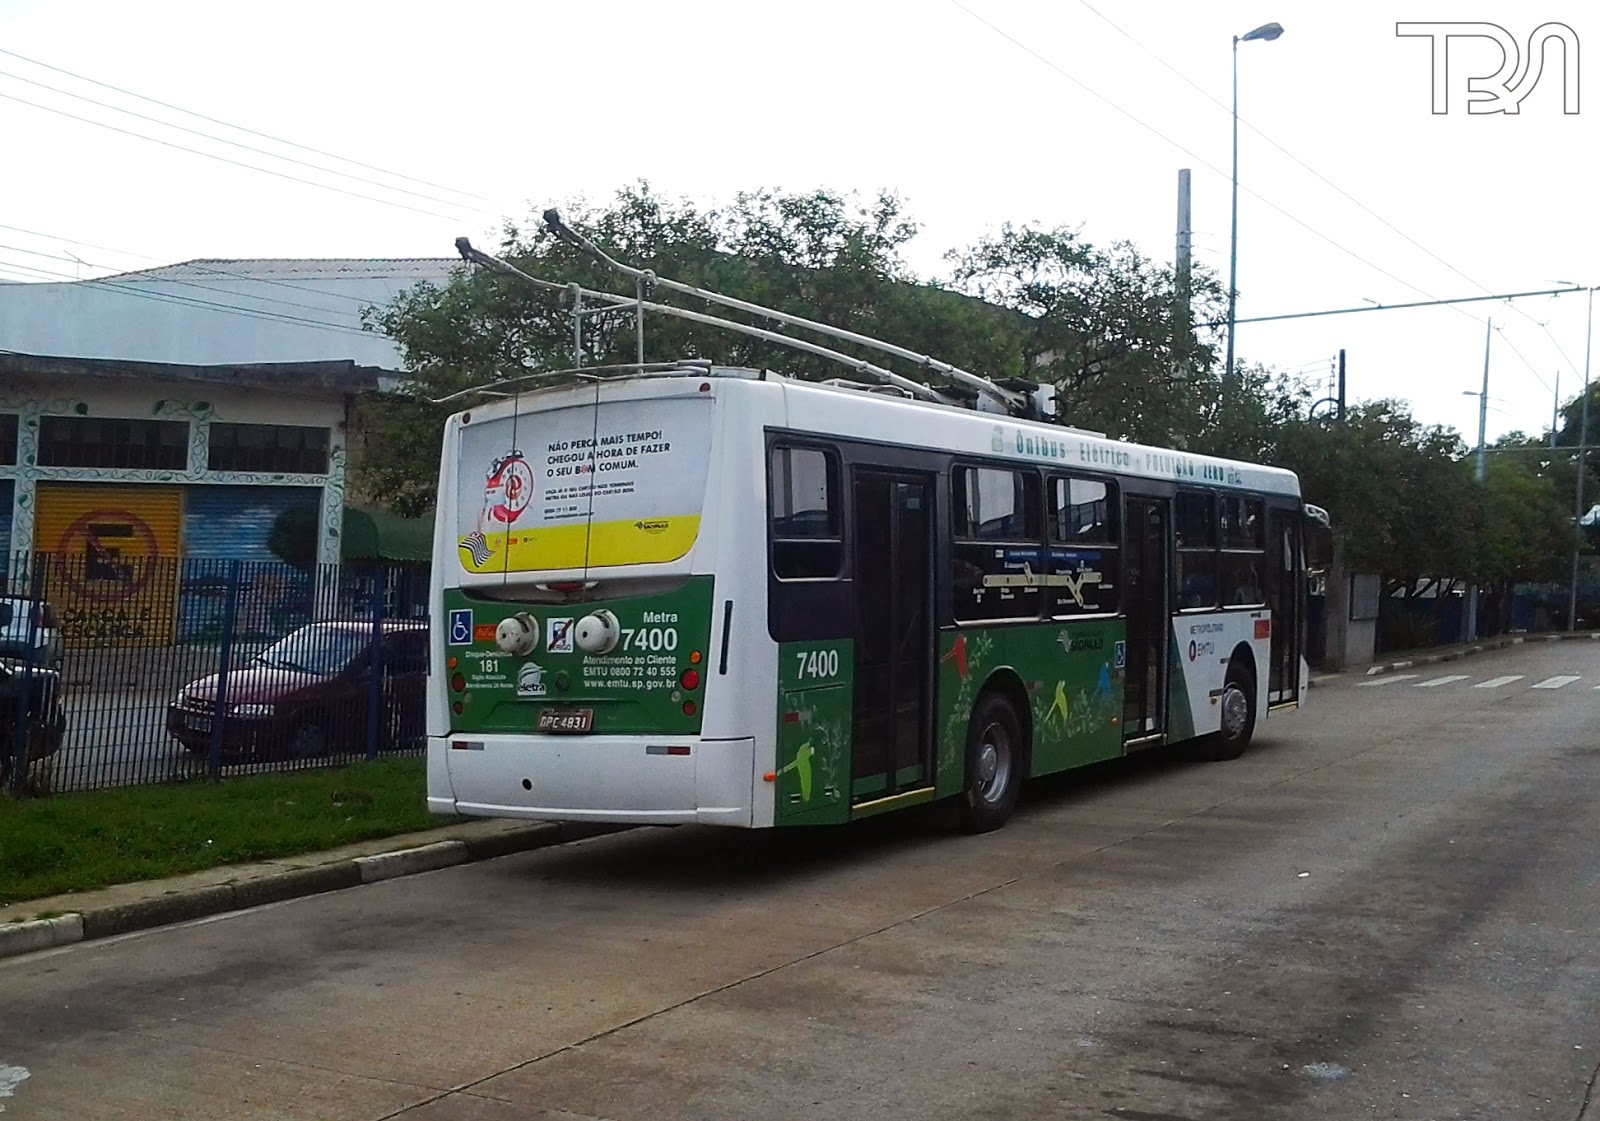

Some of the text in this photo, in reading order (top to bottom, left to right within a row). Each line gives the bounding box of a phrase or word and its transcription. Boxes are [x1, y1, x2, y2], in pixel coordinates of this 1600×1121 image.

[548, 430, 662, 452] NÃO PERCA MAIS TEMPO!
[547, 442, 671, 464] CHEGOU A HORA DE FAZER
[1016, 430, 1224, 482] Ônibus Elétrico POLUIÇÃO ZERO
[546, 460, 639, 477] O SEU BOM COMUM.
[643, 611, 678, 623] Metra
[620, 628, 678, 651] 7400
[480, 659, 499, 672] 181
[583, 655, 677, 665] Atendimento ao Cliente
[796, 649, 838, 680] 7400
[583, 666, 676, 676] EMTU 0800 72 40 555
[518, 683, 545, 692] eletra
[584, 679, 676, 690] www.emtu.sp.gov.br
[560, 716, 586, 729] 4831
